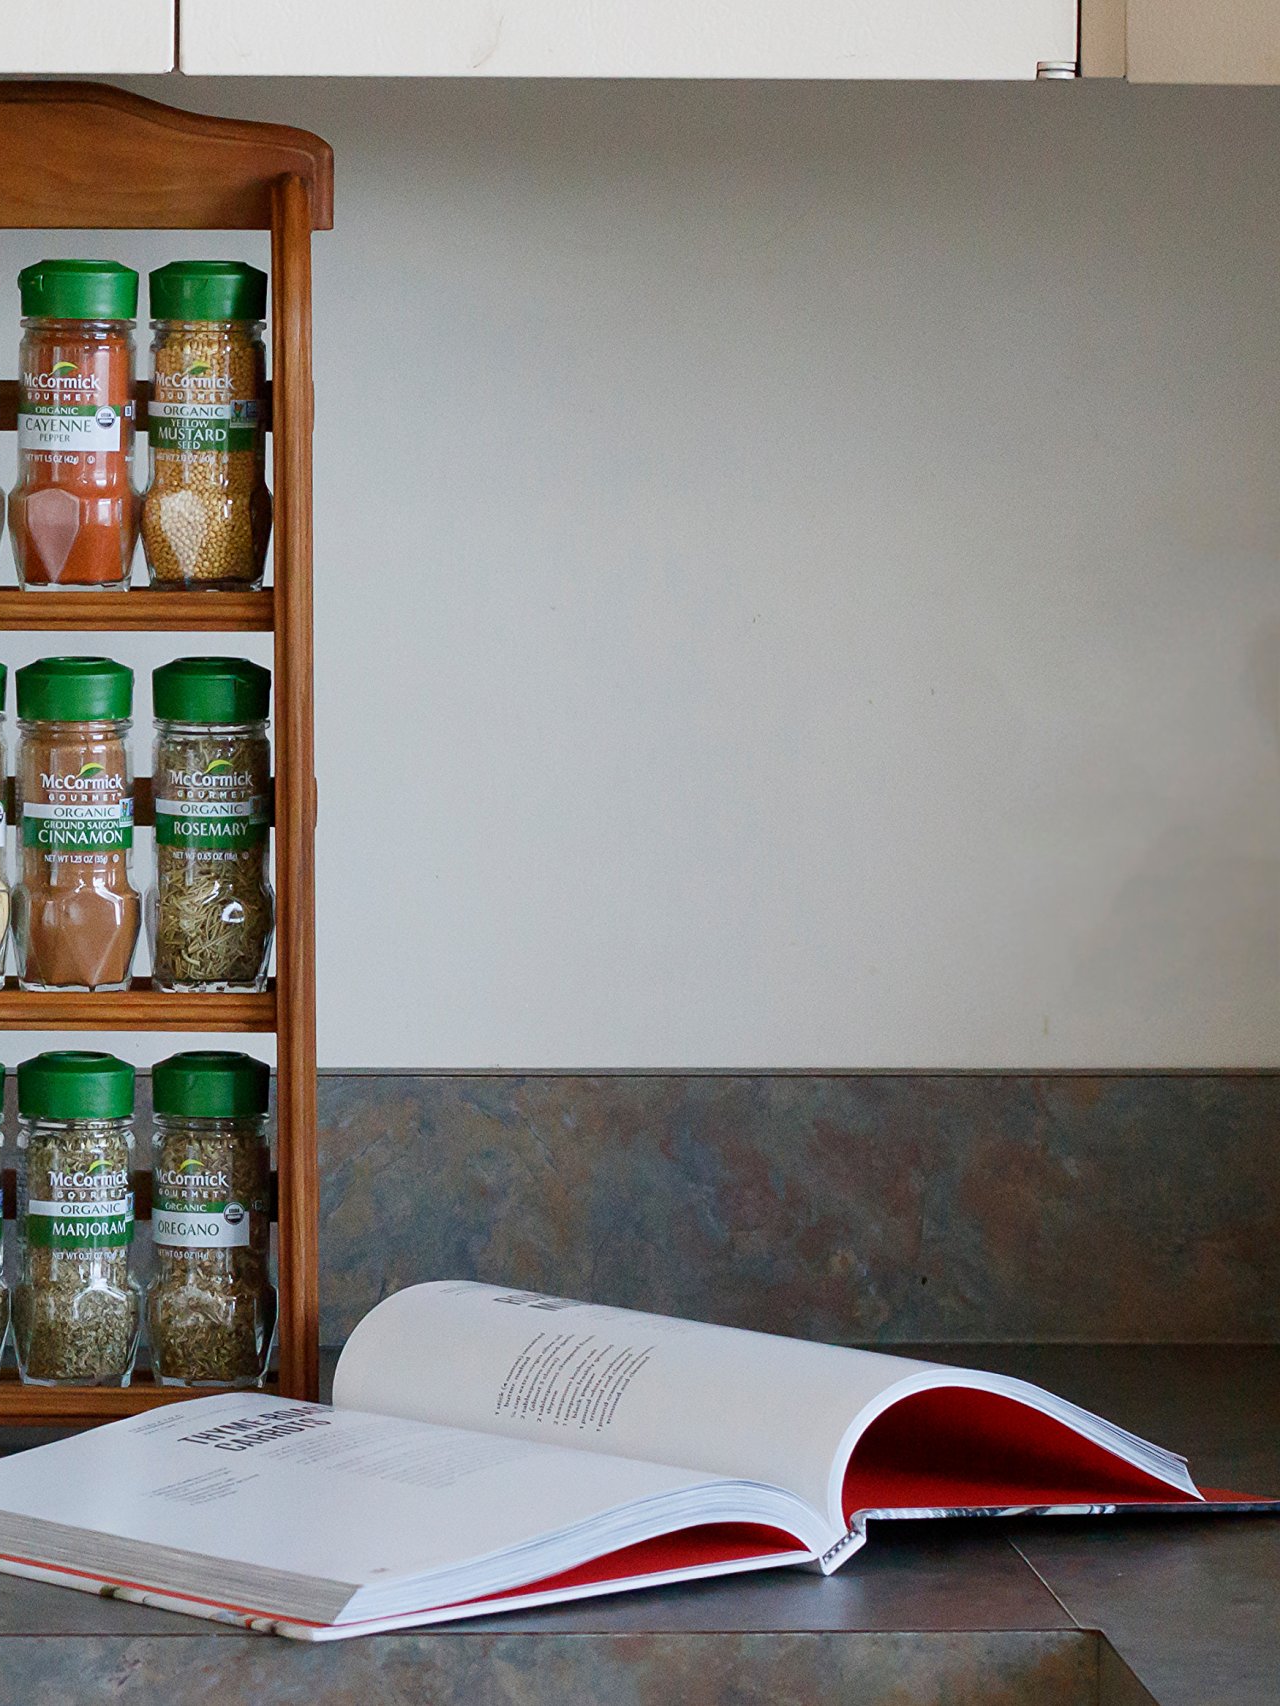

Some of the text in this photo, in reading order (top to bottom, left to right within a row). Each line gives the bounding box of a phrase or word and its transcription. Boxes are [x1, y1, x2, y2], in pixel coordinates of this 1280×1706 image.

[23, 373, 101, 389] McCormick
[155, 373, 235, 390] McCormick
[27, 393, 90, 401] GOURMET
[36, 406, 78, 415] ORGANIC
[164, 406, 224, 417] ORGANIC
[25, 418, 91, 432] CAYENNE
[171, 419, 208, 427] YELLOW
[39, 434, 70, 442] PEPPER
[159, 427, 226, 441] MUSTARD
[178, 441, 200, 450] SEED
[40, 773, 124, 790] McCormick
[170, 771, 253, 788] McCormick
[49, 792, 117, 801] GOURMET
[177, 790, 244, 798] GOURMET
[54, 807, 115, 818] ORGANIC
[180, 804, 242, 815] ORGANIC
[44, 820, 120, 830] GROUND SAIGON
[174, 822, 249, 836] ROSEMARY
[38, 829, 123, 843] CINNAMON
[83, 854, 93, 863] OZ
[49, 1170, 128, 1187] McCormick
[157, 1170, 228, 1187] McCormick
[57, 1190, 121, 1199] GOURMET
[159, 1189, 218, 1198] GOURMET
[61, 1203, 120, 1214] ORGANIC
[165, 1203, 207, 1212] ORGANIC
[53, 1223, 125, 1237] MARJORAM
[159, 1223, 219, 1236] OREGANO
[215, 1418, 331, 1451] CARROTS
